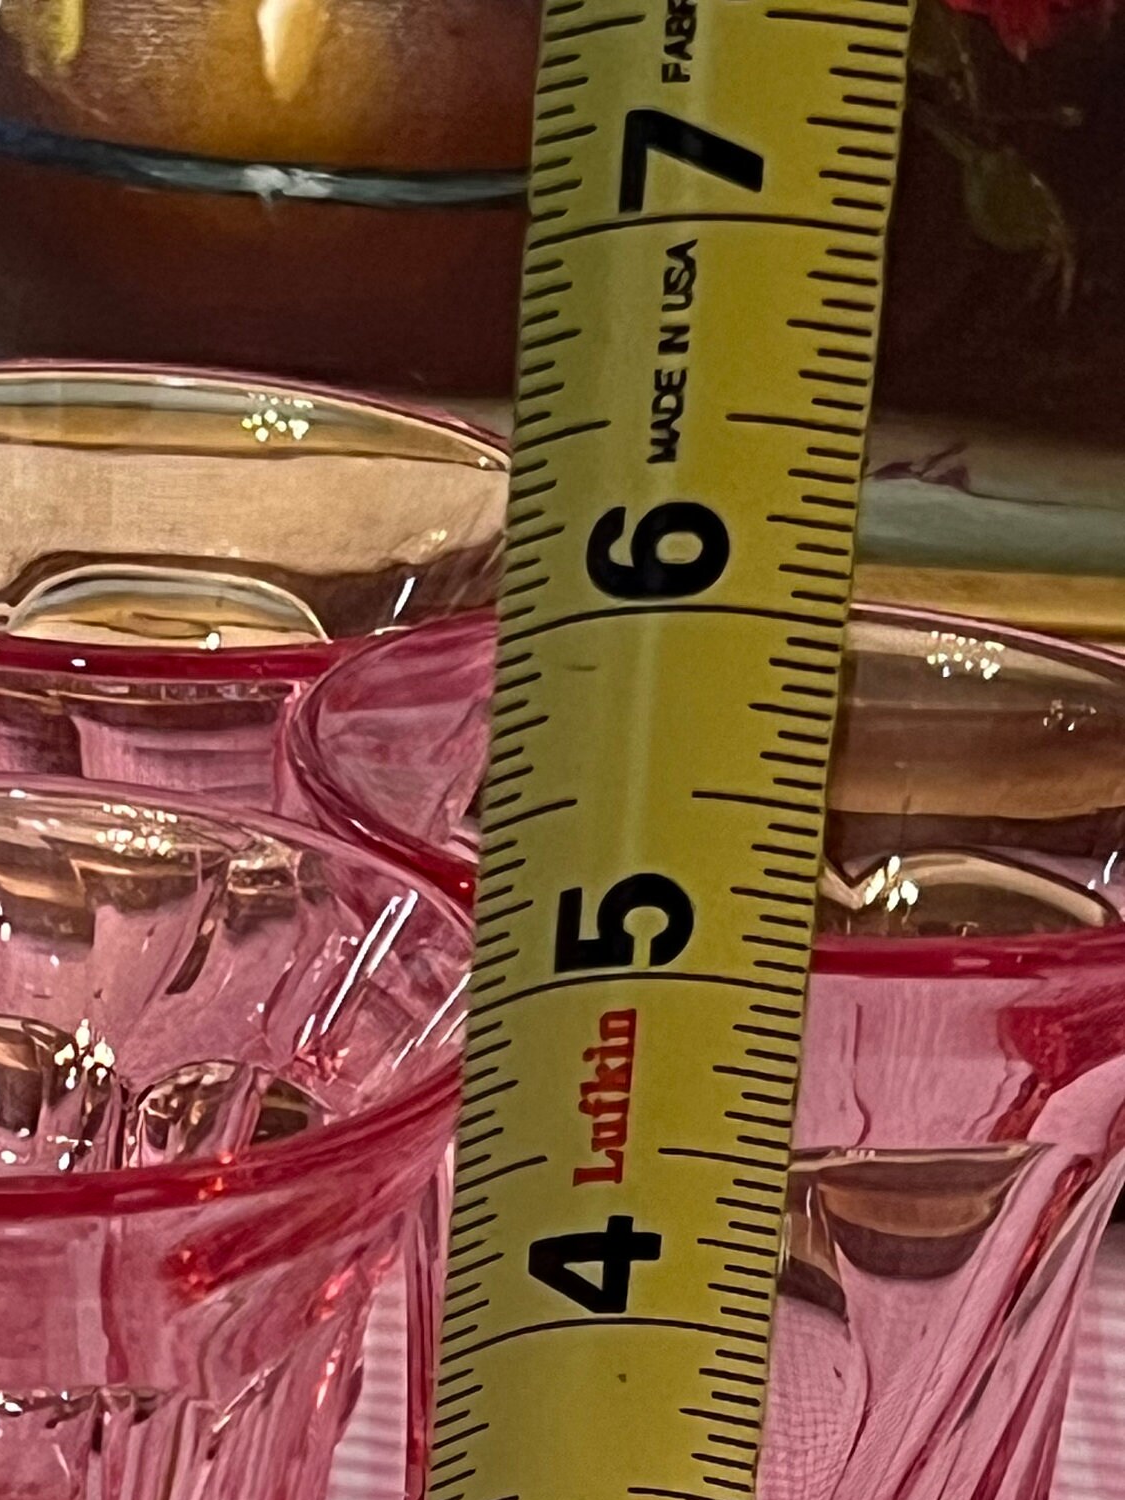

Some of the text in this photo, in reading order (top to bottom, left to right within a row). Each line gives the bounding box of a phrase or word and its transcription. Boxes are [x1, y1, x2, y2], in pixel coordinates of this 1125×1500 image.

[618, 108, 764, 213] 7
[662, 239, 698, 313] USA
[646, 368, 688, 464] MADE
[586, 502, 730, 600] 6
[554, 872, 695, 974] 5
[573, 1008, 637, 1187] Lufkin
[528, 1214, 663, 1314] 4
